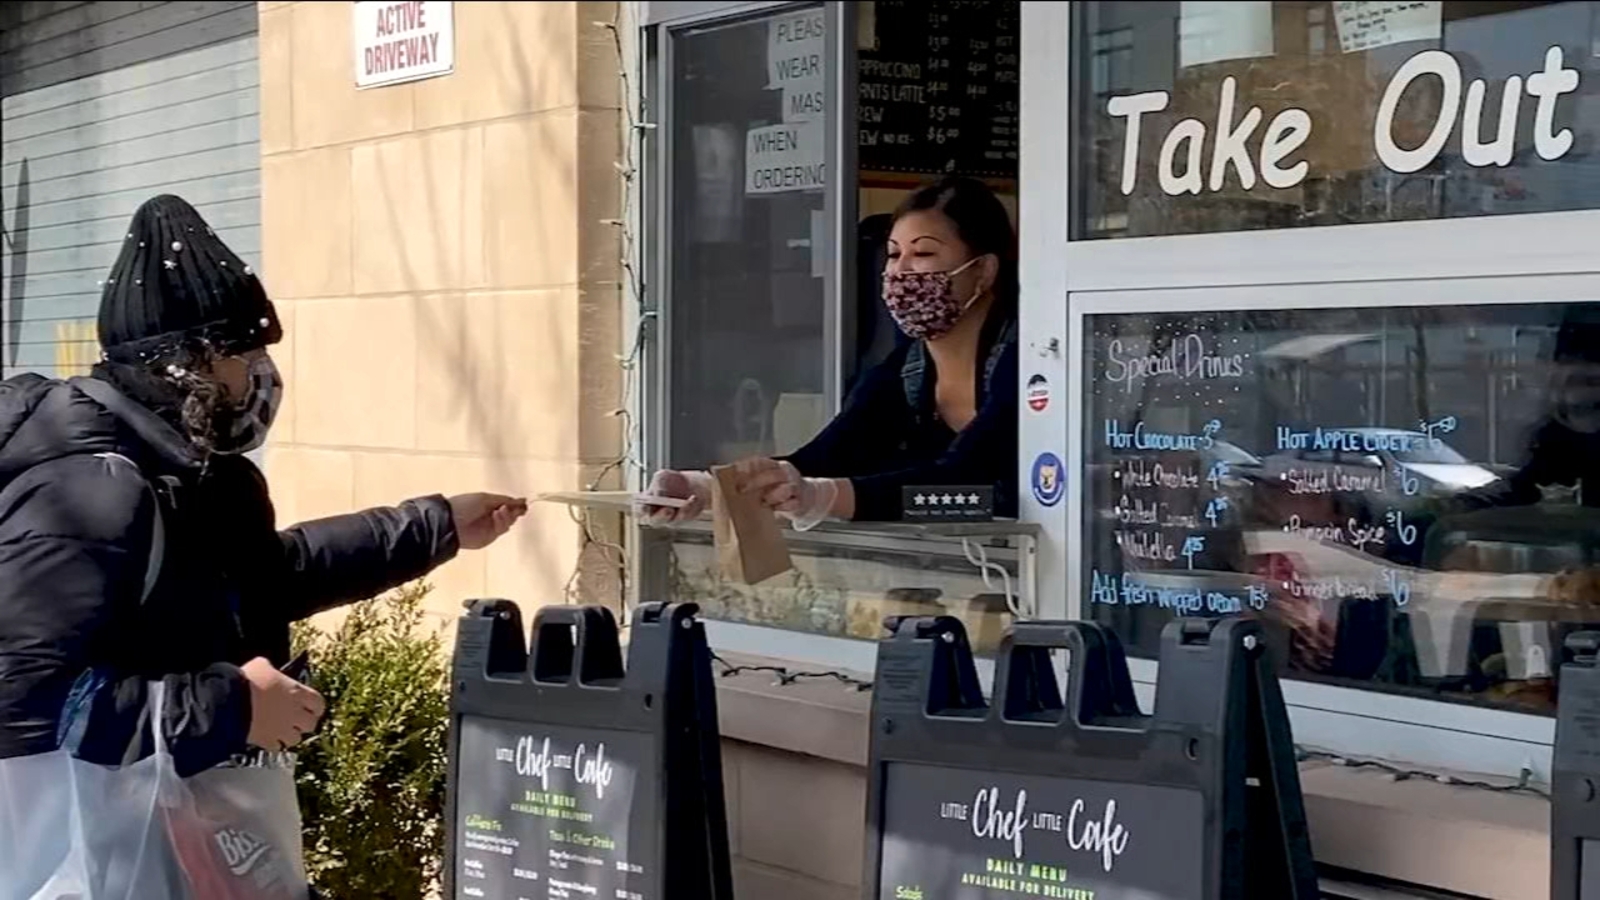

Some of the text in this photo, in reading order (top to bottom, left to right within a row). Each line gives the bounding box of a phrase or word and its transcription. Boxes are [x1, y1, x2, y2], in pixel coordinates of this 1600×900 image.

[376, 1, 426, 38] ACTIVE
[364, 32, 439, 76] DRIVEWAY
[775, 54, 820, 80] WEAR
[891, 84, 926, 104] LATTE
[1107, 76, 1311, 196] Take
[1374, 45, 1579, 173] Out
[752, 130, 798, 152] WHEN
[1105, 334, 1243, 393] Special Drinks
[1105, 419, 1133, 448] HOT
[1277, 426, 1309, 450] HOT
[1313, 427, 1361, 451] APPLE
[1364, 432, 1411, 452] CIDER
[1288, 468, 1331, 494] Salted
[1333, 465, 1388, 493] Caramel
[1348, 517, 1386, 551] Spice
[1386, 506, 1417, 544] $6
[1091, 569, 1119, 604] Add
[516, 735, 552, 791] Chef
[574, 743, 613, 799] Cafe
[525, 790, 549, 804] DAILY
[940, 787, 1129, 872] LITTLE Chef LITTLE Cafe
[986, 858, 1068, 883] DAILY MENU
[962, 873, 1095, 900] AVAILABLE FOR DELIVERY
